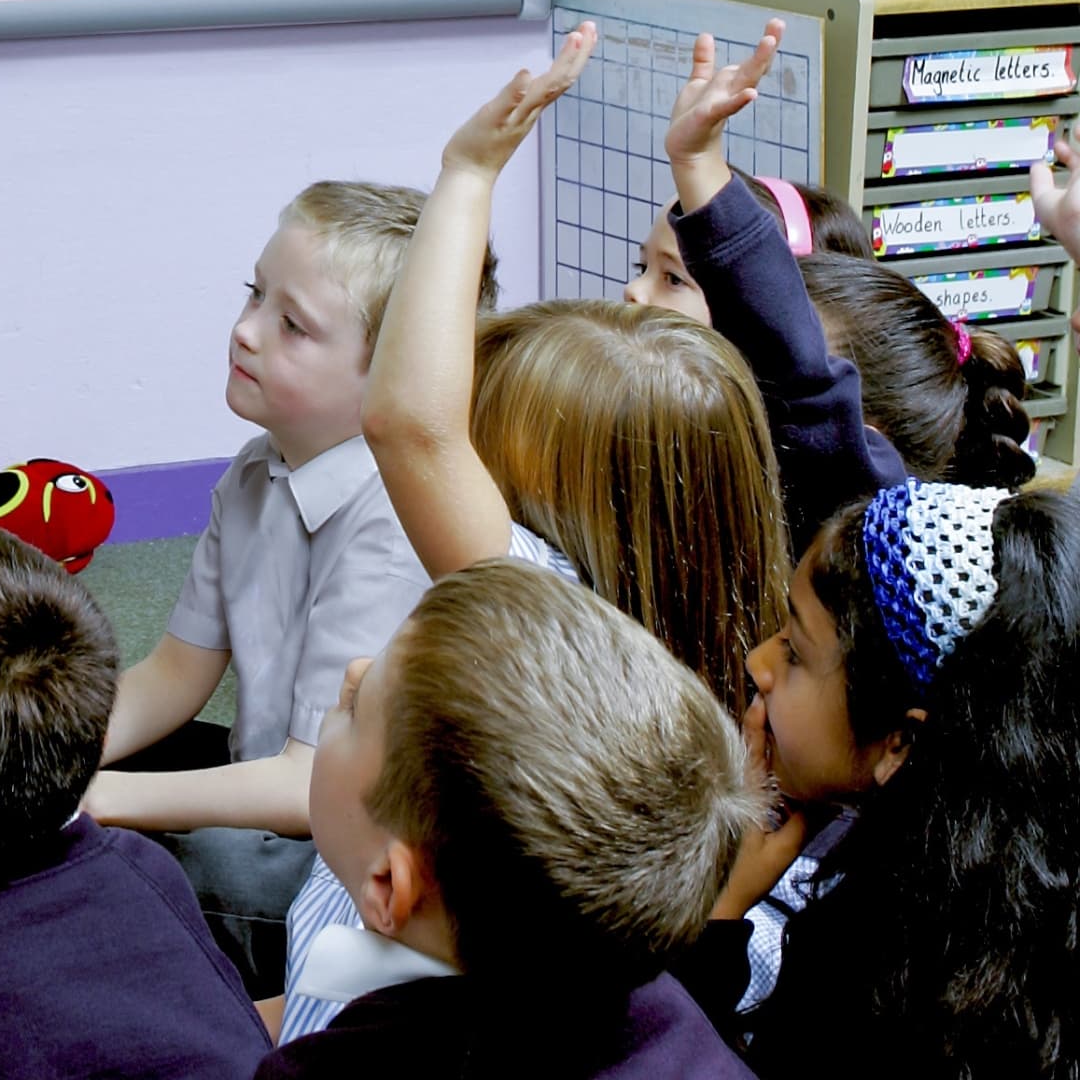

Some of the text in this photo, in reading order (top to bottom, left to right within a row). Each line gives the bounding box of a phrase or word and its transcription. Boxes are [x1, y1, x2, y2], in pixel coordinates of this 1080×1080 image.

[910, 55, 1056, 96] Magnetic letters.
[880, 208, 1015, 235] Wooden letters.
[936, 288, 993, 310] shapes.
